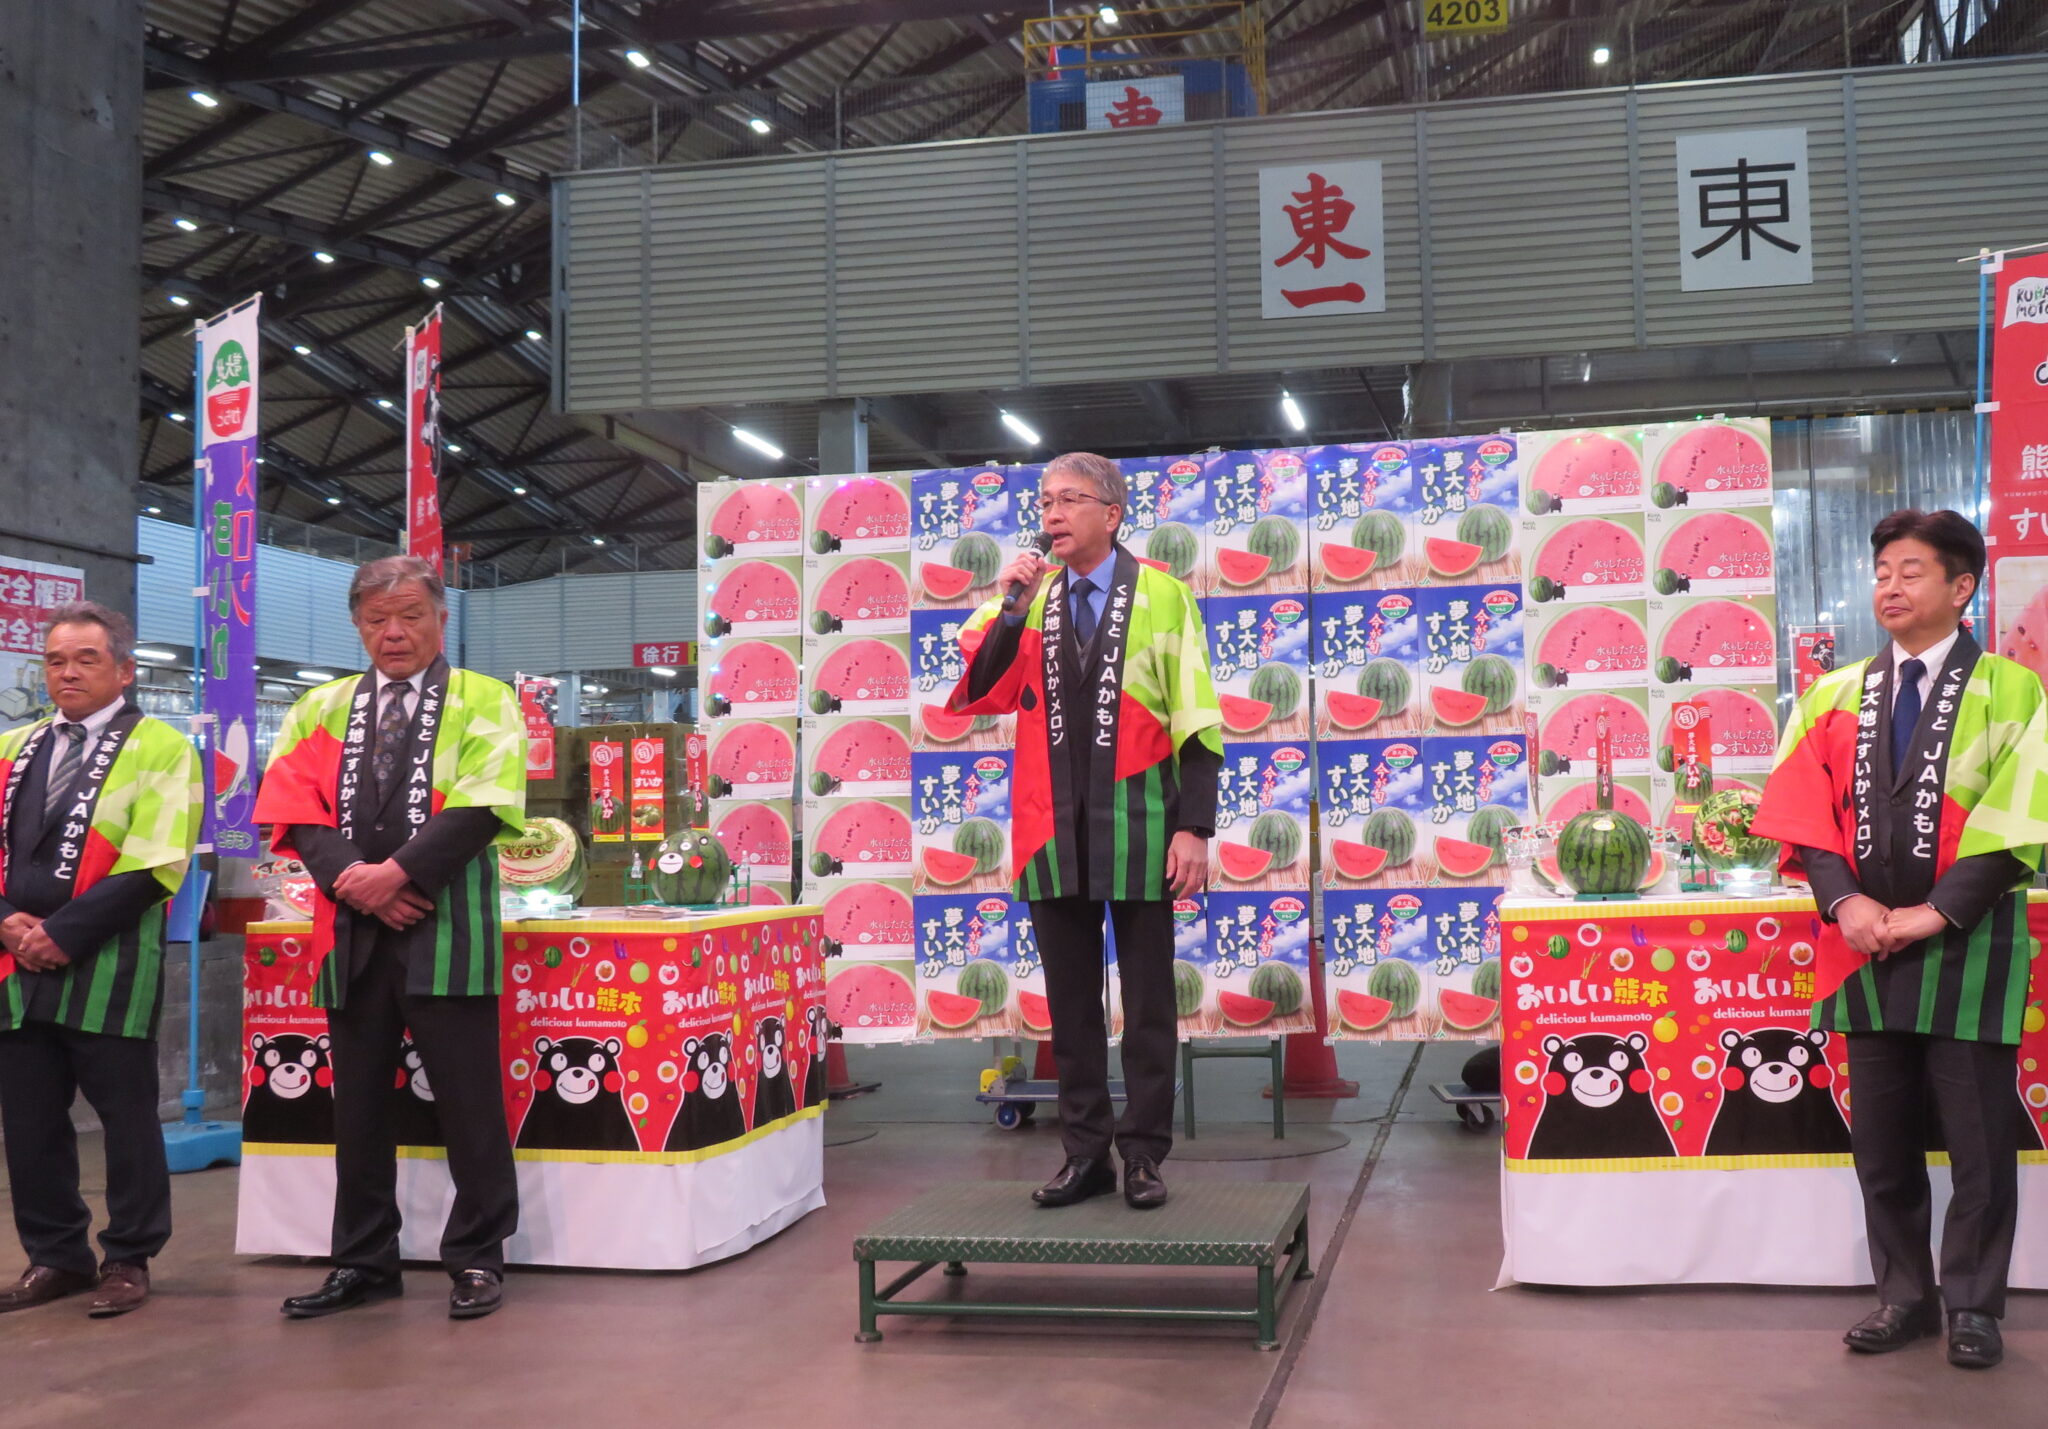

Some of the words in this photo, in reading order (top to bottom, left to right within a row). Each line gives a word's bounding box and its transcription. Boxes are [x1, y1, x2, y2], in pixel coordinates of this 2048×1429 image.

[1427, 0, 1500, 26] 4203
[1690, 158, 1801, 260] 東
[1274, 172, 1371, 308] 東一
[1339, 458, 1361, 518] 夢大地
[1361, 466, 1380, 507] 今が旬
[1443, 452, 1465, 512] 夢大地
[1466, 459, 1485, 501] 今が旬
[1590, 470, 1641, 481] 水もしたたる
[1594, 482, 1640, 495] すいか
[1716, 463, 1768, 475] 水もしたたる
[1721, 475, 1768, 488] すいか
[940, 481, 960, 539] 夢大地
[960, 489, 978, 529] 今が旬
[1135, 471, 1156, 531] 夢大地
[1156, 479, 1174, 519] 今が旬
[1213, 476, 1235, 536] すいか
[1236, 464, 1257, 523] 夢大地
[1257, 471, 1276, 513] 今が旬
[1316, 470, 1338, 530] すいか
[1420, 464, 1443, 524] すいか
[869, 524, 908, 536] すいか
[919, 492, 939, 550] すいか
[1593, 557, 1644, 569] 水もしたたる
[1597, 569, 1644, 582] すいか
[1718, 552, 1770, 562] 水もしたたる
[1723, 563, 1770, 577] すいか
[759, 607, 798, 618] すいか
[872, 605, 908, 617] すいか
[1108, 584, 1127, 638] くまもと
[1448, 601, 1471, 662] 夢大地
[1471, 609, 1491, 650] 今が旬
[642, 646, 680, 664] 徐行
[940, 623, 960, 682] 夢大地
[1215, 621, 1237, 681] すいか
[1237, 609, 1258, 670] 夢大地
[1258, 618, 1277, 659] 今が旬
[1321, 617, 1344, 678] すいか
[1344, 605, 1366, 666] 夢大地
[1366, 613, 1385, 655] 今が旬
[1425, 613, 1449, 674] すいか
[1596, 645, 1647, 656] 水もしたたる
[1720, 640, 1772, 651] 水もしたたる
[918, 634, 939, 692] すいか
[1600, 657, 1647, 670] すいか
[418, 684, 440, 742] くまもと
[759, 688, 797, 699] すいか
[871, 687, 909, 698] すいか
[1046, 645, 1064, 746] すいか・メロン
[1095, 647, 1118, 747] JAかもと
[1857, 670, 1885, 727] 夢大地
[1931, 668, 1962, 731] くまもと
[347, 692, 372, 743] 夢大地
[1680, 709, 1698, 728] 旬
[1722, 729, 1774, 740] 水もしたたる
[88, 730, 123, 780] くまもと
[1727, 741, 1774, 755] すいか
[633, 777, 663, 788] すいか
[759, 768, 793, 780] すいか
[872, 768, 912, 780] すいか
[1238, 757, 1260, 817] 夢大地
[1259, 765, 1278, 807] 今が旬
[1349, 754, 1372, 816] 夢大地
[1372, 762, 1391, 805] 今が旬
[1454, 751, 1476, 813] 夢大地
[1478, 760, 1496, 802] 今が旬
[1686, 753, 1700, 789] すいか
[602, 788, 614, 819] すいか
[919, 775, 940, 835] すいか
[941, 765, 962, 824] 夢大地
[962, 774, 982, 814] 今が旬
[1215, 767, 1237, 828] すいか
[1326, 766, 1350, 827] すいか
[1431, 762, 1454, 823] すいか
[1855, 742, 1873, 860] すいか・メロン
[1912, 741, 1944, 859] JAかもと
[54, 787, 97, 880] JAかもと
[874, 848, 912, 860] すいか
[874, 931, 914, 943] すいか
[922, 918, 945, 978] すいか
[943, 907, 966, 967] 夢大地
[966, 915, 984, 956] 今が旬
[1215, 916, 1237, 978] すいか
[1237, 905, 1258, 968] 夢大地
[1257, 915, 1276, 957] 今が旬
[1332, 915, 1355, 976] すいか
[1354, 904, 1377, 966] 夢大地
[1378, 913, 1397, 955] 今が旬
[1434, 913, 1458, 976] すいか
[1458, 902, 1480, 964] 夢大地
[1480, 911, 1500, 953] 今が旬
[516, 986, 643, 1015] おいしい熊本
[662, 981, 737, 1015] おいしい熊本
[744, 969, 790, 1001] おいしい熊本
[1516, 977, 1668, 1011] おいしい熊本
[530, 1017, 573, 1028] delicious
[576, 1017, 627, 1028] kumamoto
[678, 1014, 711, 1029] delicious
[873, 1013, 914, 1024] すいか
[1536, 1012, 1587, 1025] delicious
[1590, 1011, 1653, 1024] kumamoto
[1713, 1006, 1766, 1020] delicious
